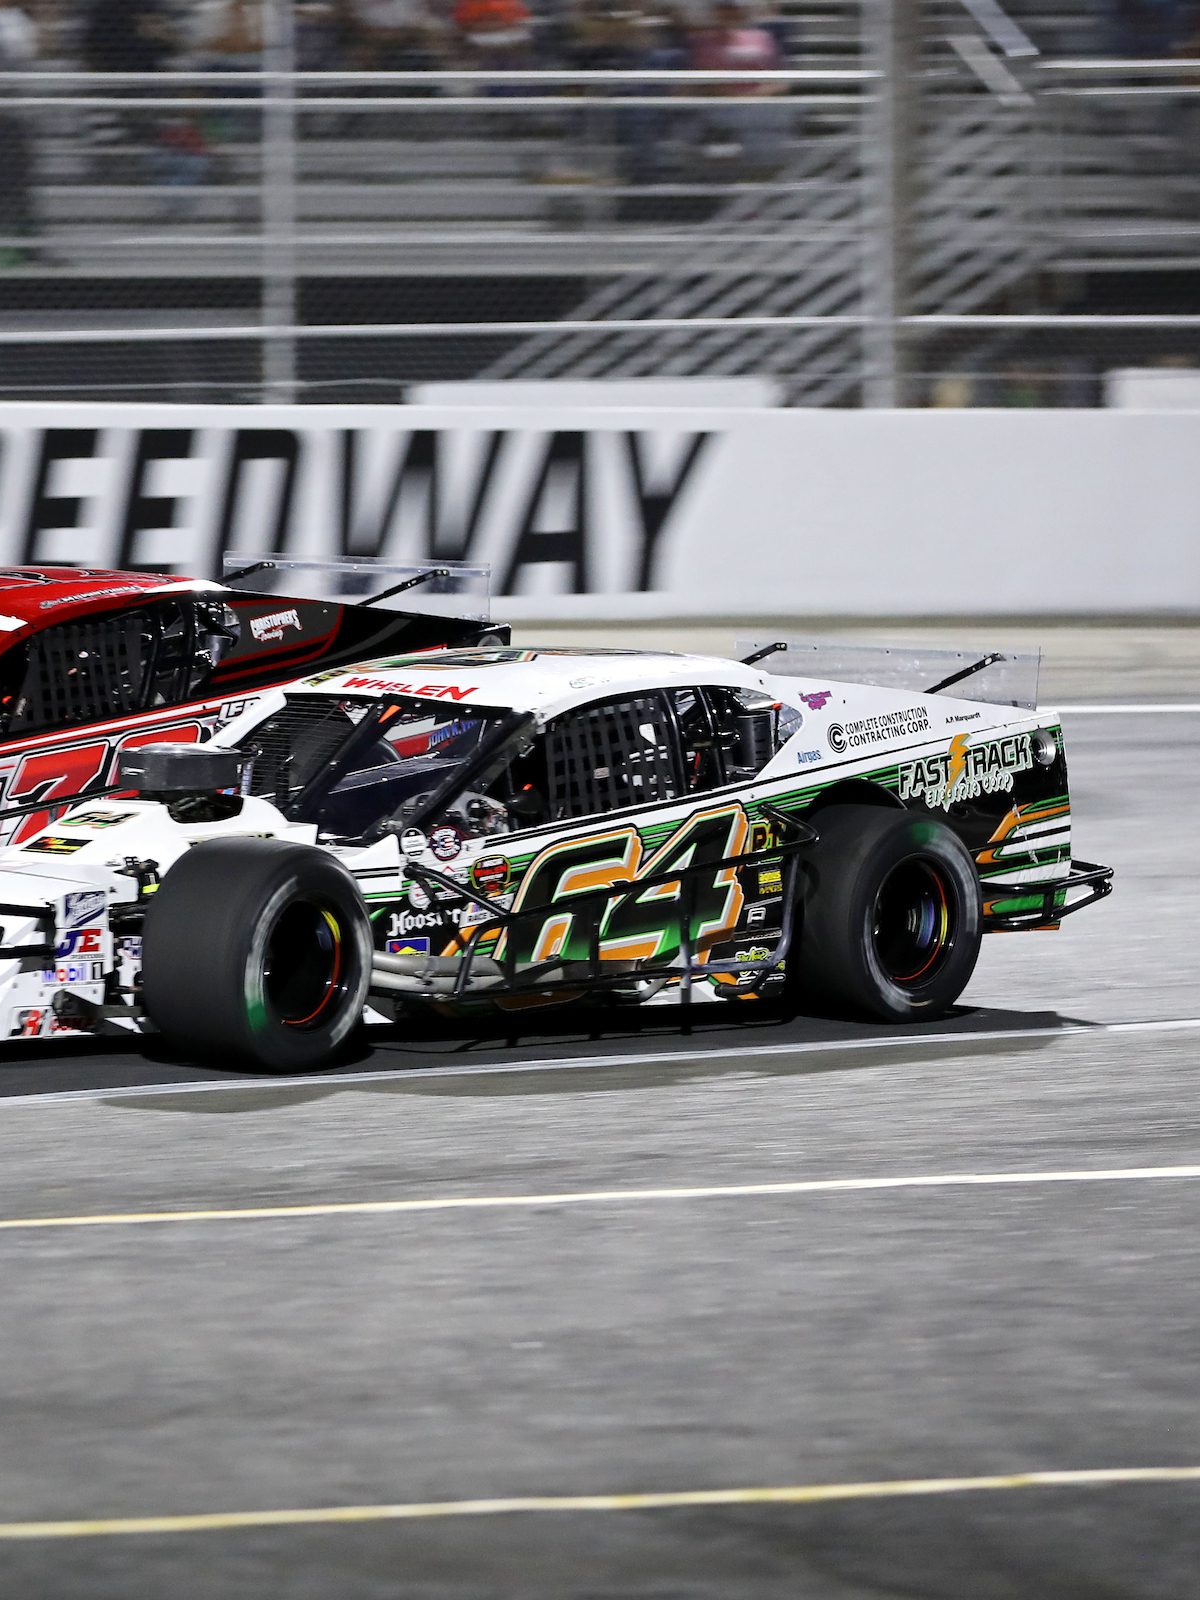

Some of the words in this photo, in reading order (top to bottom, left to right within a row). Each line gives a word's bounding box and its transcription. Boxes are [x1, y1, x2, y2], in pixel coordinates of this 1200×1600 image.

[342, 677, 480, 700] WHELEN
[845, 717, 878, 735] COMPLETE
[878, 706, 928, 728] CONSTRUCTION
[849, 725, 906, 747] CONTRACTING
[907, 719, 932, 735] CORP.
[798, 750, 821, 764] Airgas
[899, 753, 953, 800] FAST
[964, 734, 1033, 780] TRACK
[493, 800, 749, 966] 64
[386, 908, 461, 936] Hoosir
